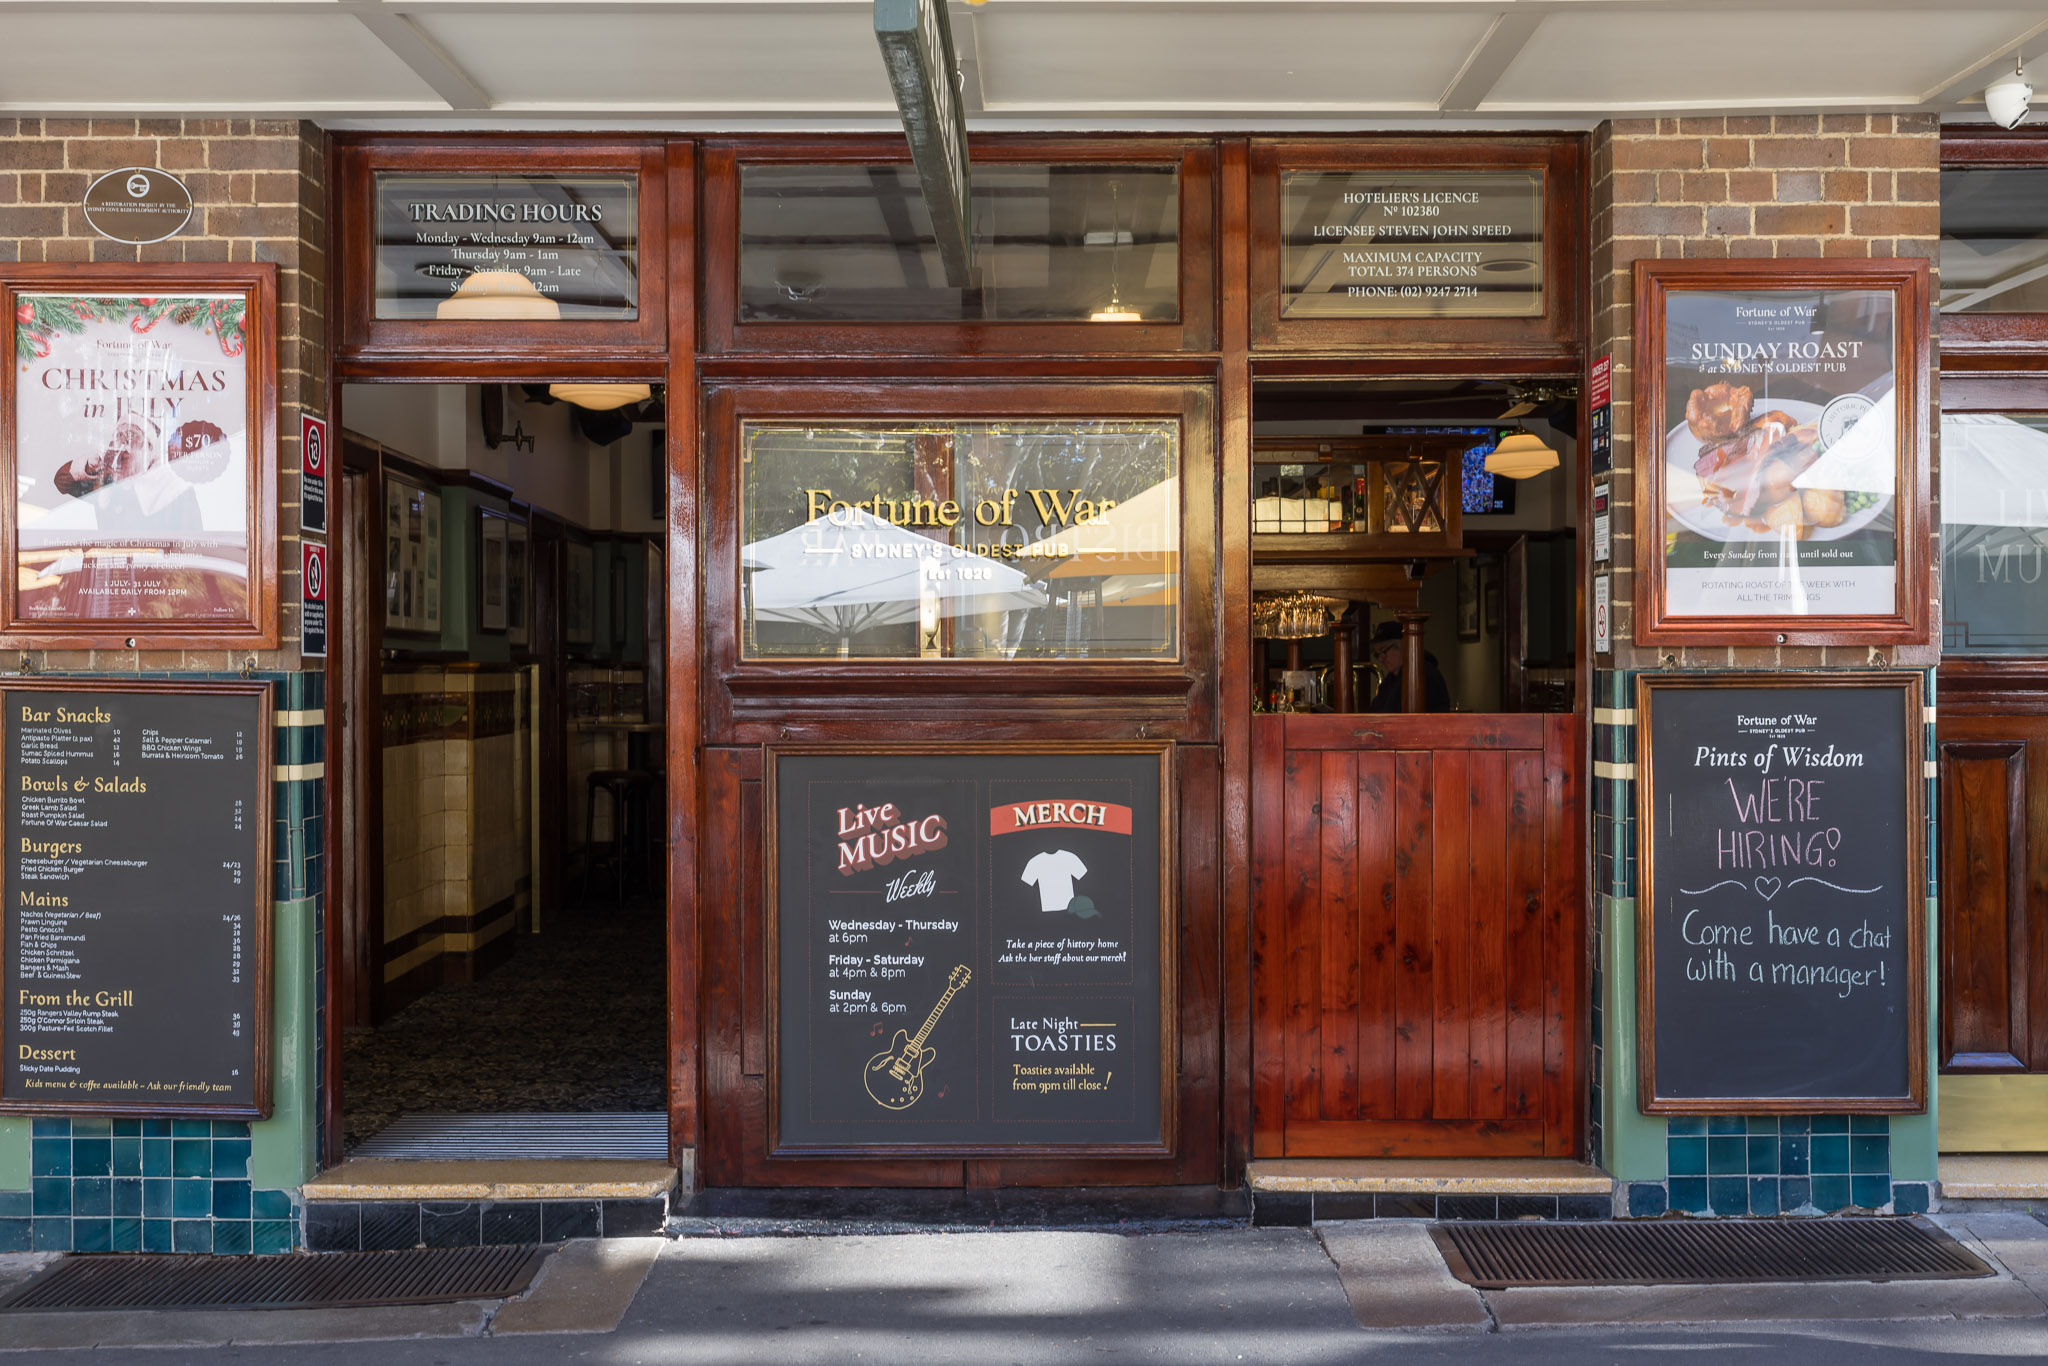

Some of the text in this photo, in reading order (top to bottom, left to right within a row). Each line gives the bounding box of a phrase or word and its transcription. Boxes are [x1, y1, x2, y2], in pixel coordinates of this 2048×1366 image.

[1344, 192, 1479, 204] HOTELIER'S LICENCE
[409, 203, 602, 222] TRADING HOURS
[1402, 206, 1439, 216] 102380
[416, 232, 594, 246] Monday Wednesday 9am 12am
[1314, 225, 1511, 239] LICENSEE STEVEN JOHN SPEED
[451, 249, 558, 262] Thursday 9am 1am
[1343, 252, 1482, 263] MAXIMUM CAPACITY
[429, 265, 463, 278] Friday
[524, 265, 546, 276] 9am
[558, 265, 581, 276] Late
[1348, 266, 1477, 277] TOTAL 374 PERSONS
[1348, 286, 1477, 298] PHONE: (02) 9247 2714
[1736, 306, 1817, 317] Fortune of War
[1692, 342, 1863, 359] SUNDAY ROAST
[1708, 362, 1846, 373] at SYDNEY'S OLDEST PUB
[42, 369, 226, 392] CHRISTMAS
[84, 397, 184, 419] in JULY
[185, 434, 211, 449] $70
[804, 488, 1116, 527] Fortune of War
[851, 544, 1068, 558] SYDNEY'S OLDEST PUB
[1704, 551, 1726, 561] Every
[1728, 550, 1755, 560] Sunday
[1758, 550, 1777, 559] from
[1801, 549, 1820, 559] until
[1822, 549, 1838, 559] sold
[1840, 550, 1853, 558] out
[22, 706, 111, 723] Bar Snacks
[1737, 715, 1817, 726] Fortune of War
[1694, 745, 1864, 774] Pints of Wisdom
[22, 775, 146, 793] Bowls & Salads
[1724, 777, 1825, 824] WE'RE
[1013, 803, 1106, 828] MERCH
[838, 802, 942, 870] Live MUSIC
[21, 838, 82, 858] Burgers
[1718, 828, 1841, 870] HIRING!
[64, 866, 84, 874] Burger
[886, 869, 936, 903] Weekly
[21, 891, 68, 906] Mains
[829, 919, 958, 932] Wednesday Thursday
[1682, 909, 1891, 949] Come have a chat
[1006, 939, 1025, 949] Take
[1035, 939, 1054, 951] piece
[1057, 938, 1065, 950] of
[1067, 939, 1095, 951] history
[1098, 939, 1118, 948] home
[829, 955, 924, 967] Friday Saturday
[829, 967, 906, 980] at 4pm & 8pm
[1687, 949, 1886, 998] with a manager!
[20, 990, 133, 1007] From the Grill
[830, 990, 871, 1002] Sunday
[829, 1002, 907, 1015] at 2pm & 6pm
[1011, 1017, 1078, 1032] Late Night
[1011, 1034, 1116, 1052] TOASTIES
[19, 1045, 75, 1060] Dessert
[20, 1065, 37, 1073] Sticky
[55, 1066, 80, 1074] Pudding
[1013, 1064, 1094, 1075] Toasties available
[25, 1079, 43, 1088] Kids
[45, 1081, 67, 1089] menu
[70, 1079, 77, 1089] &
[80, 1079, 101, 1090] coffee
[103, 1079, 138, 1090] available
[147, 1082, 162, 1090] Ask
[164, 1083, 178, 1091] our
[179, 1081, 210, 1093] friendly
